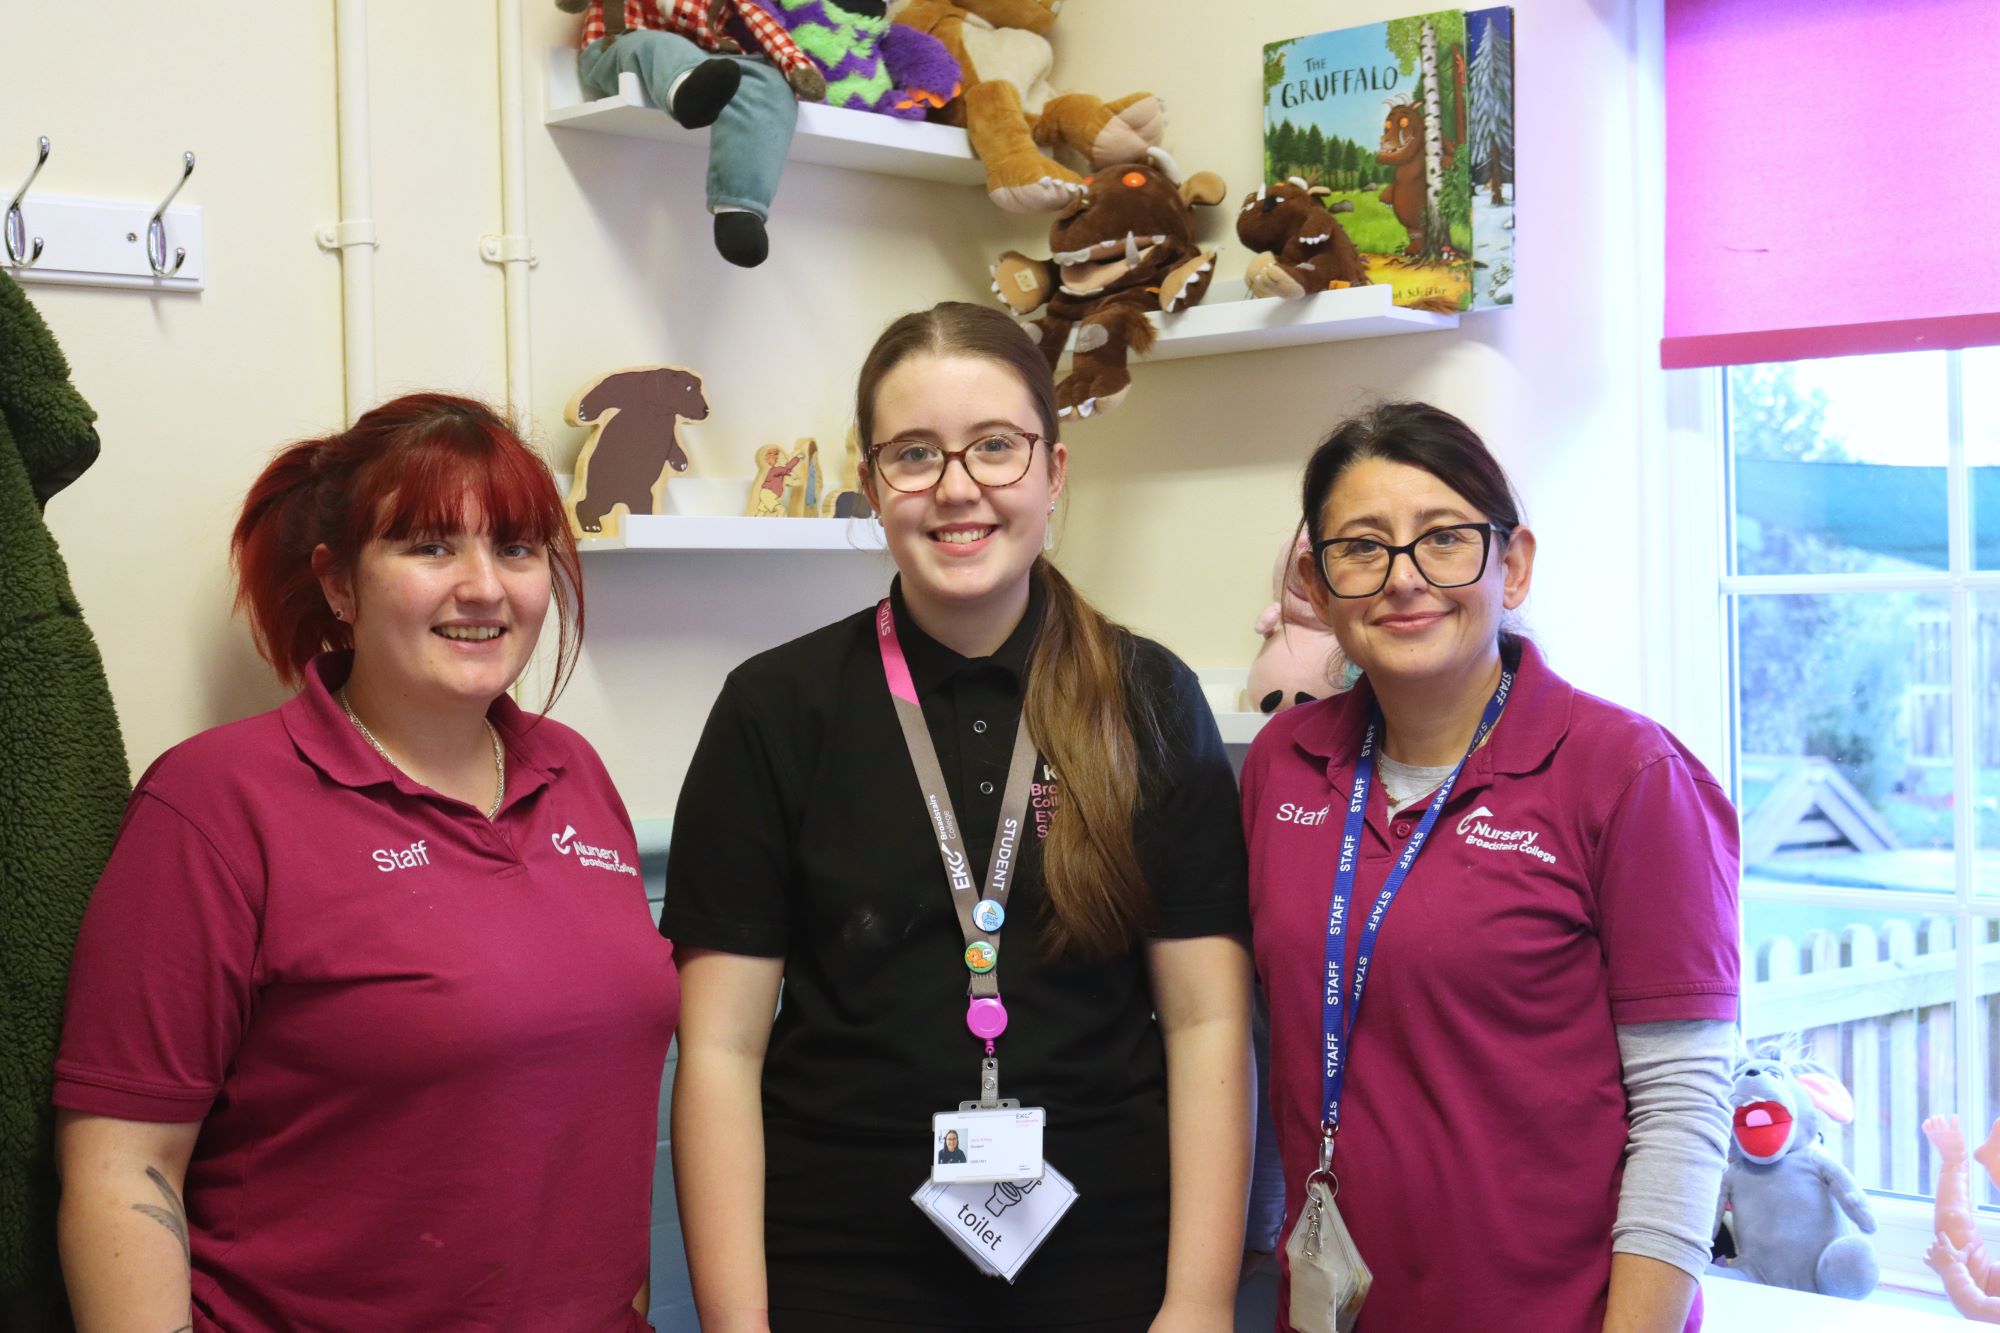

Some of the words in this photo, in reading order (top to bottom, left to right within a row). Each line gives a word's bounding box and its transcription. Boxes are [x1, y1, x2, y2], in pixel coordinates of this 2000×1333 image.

[1304, 57, 1326, 73] THE
[1281, 65, 1398, 109] GRUFFALO
[1497, 672, 1512, 706] STAFF
[1361, 723, 1376, 758] STAFF
[1351, 778, 1365, 813] STAFF
[1432, 775, 1455, 811] STAFF
[930, 794, 948, 841] Broadstairs
[944, 810, 957, 840] College
[1276, 803, 1330, 826] Staff
[1473, 820, 1539, 843] Nursery
[371, 839, 431, 873] Staff
[992, 818, 1018, 891] STUDENT
[1340, 835, 1356, 872] STAFF
[1400, 832, 1424, 870] STAFF
[1465, 834, 1518, 852] Broadstairs
[1519, 843, 1557, 864] College
[946, 850, 970, 890] EKC
[1330, 894, 1345, 935] STAFF
[1368, 891, 1391, 932] STAFF
[1327, 961, 1340, 1006] STAFF
[1354, 956, 1368, 1000] STAFF
[1327, 1032, 1339, 1078] STAFF
[957, 1203, 1002, 1251] toilet
